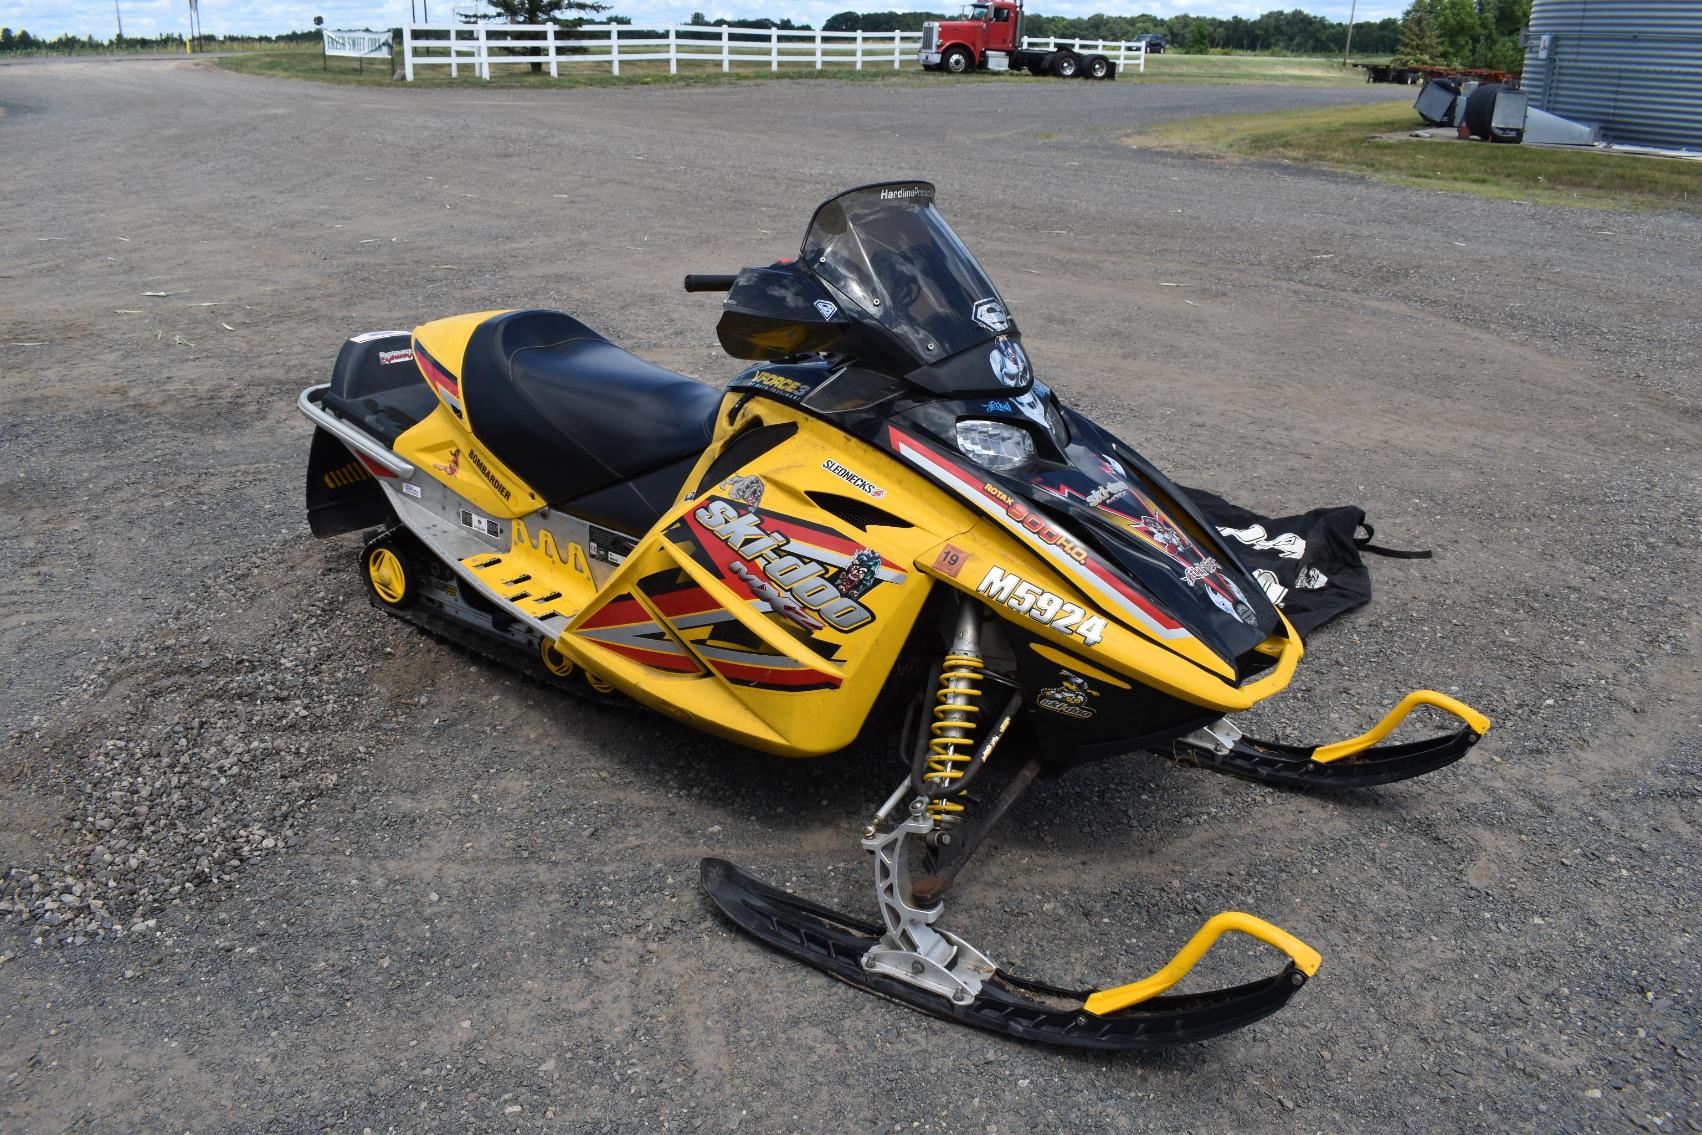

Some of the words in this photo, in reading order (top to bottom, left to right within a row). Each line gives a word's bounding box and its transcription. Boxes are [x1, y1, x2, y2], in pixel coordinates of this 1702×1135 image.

[468, 449, 511, 501] BOMBARDIER
[822, 459, 876, 494] SLEDNECKS
[984, 482, 1015, 506] ROTAX
[942, 550, 960, 566] 19
[976, 565, 1109, 647] M5924
